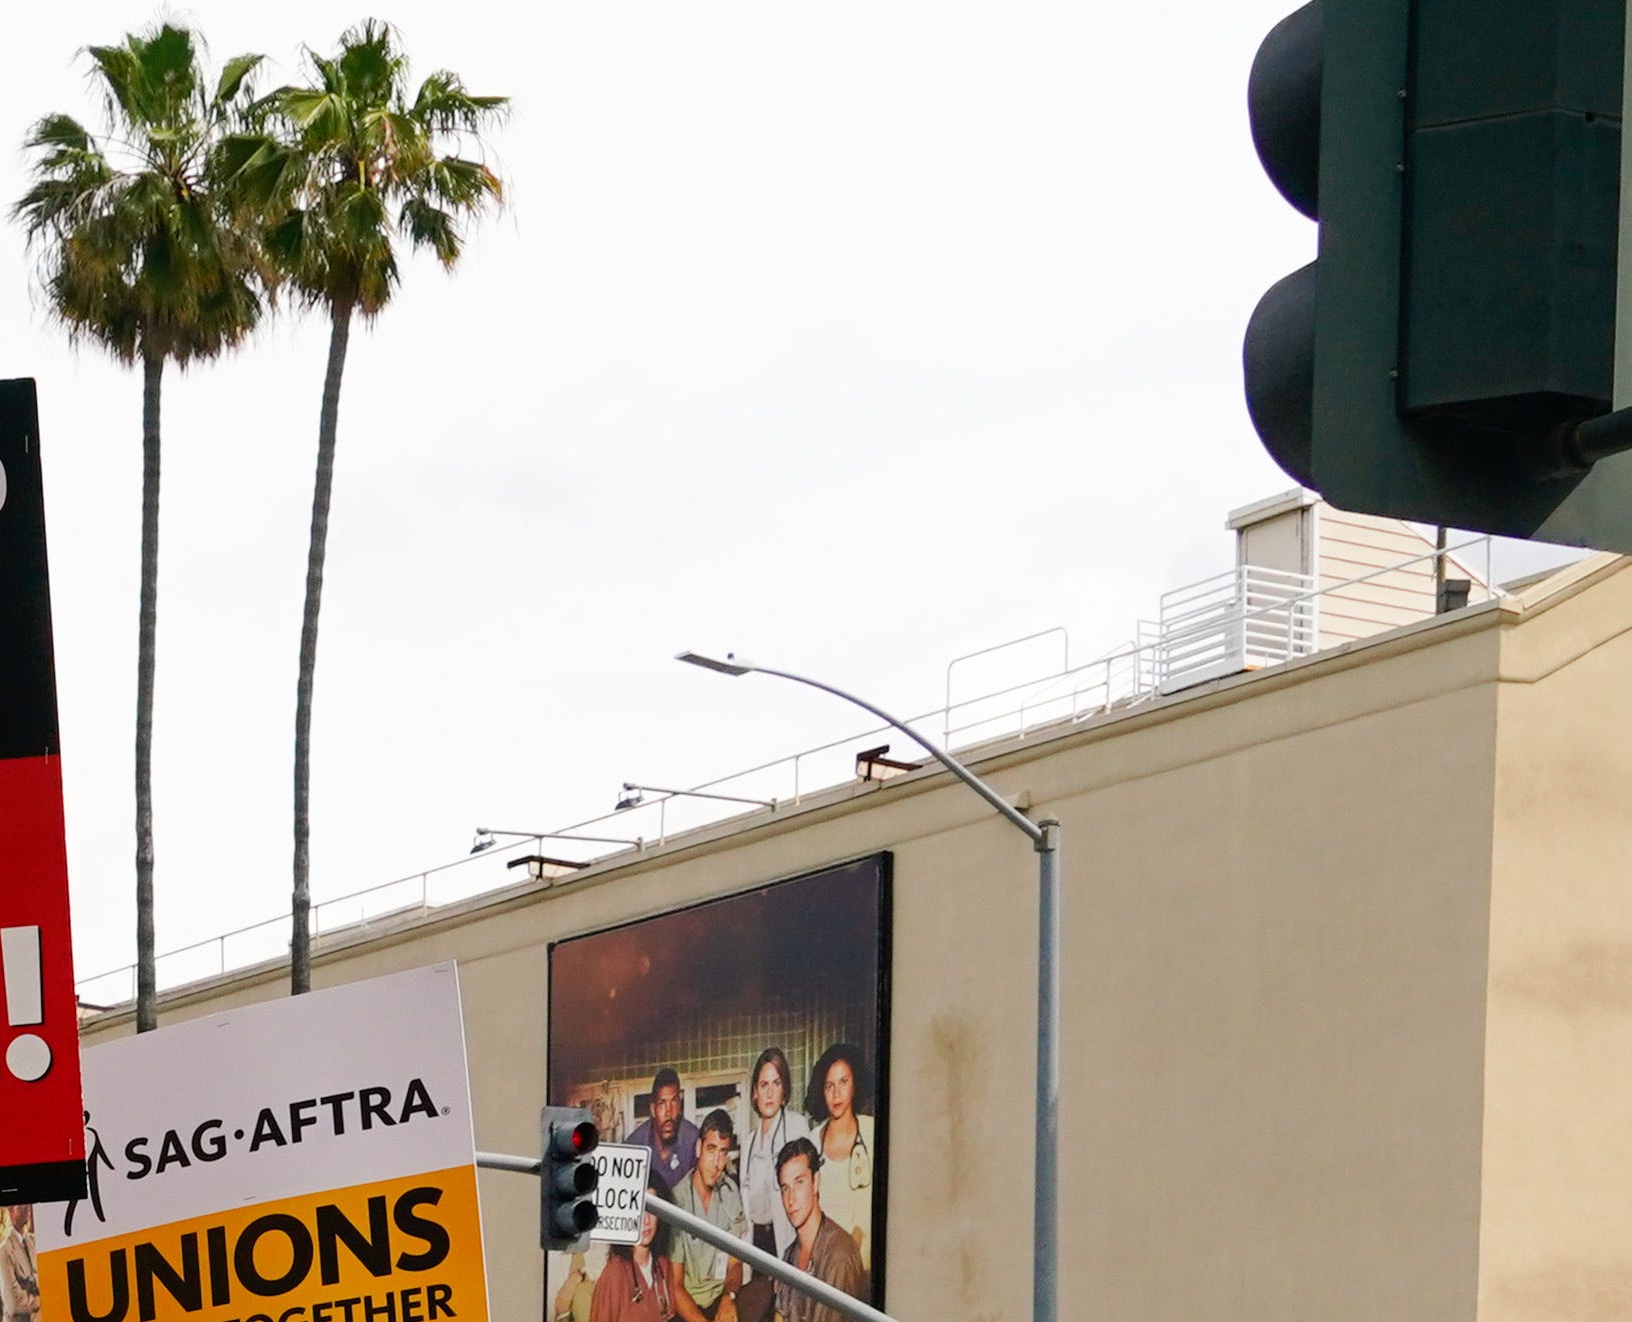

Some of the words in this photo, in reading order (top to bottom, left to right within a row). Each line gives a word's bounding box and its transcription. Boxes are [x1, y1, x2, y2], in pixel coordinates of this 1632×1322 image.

[612, 1157, 643, 1179] NOT
[597, 1188, 640, 1210] LOCK
[598, 1216, 639, 1231] RSECTION
